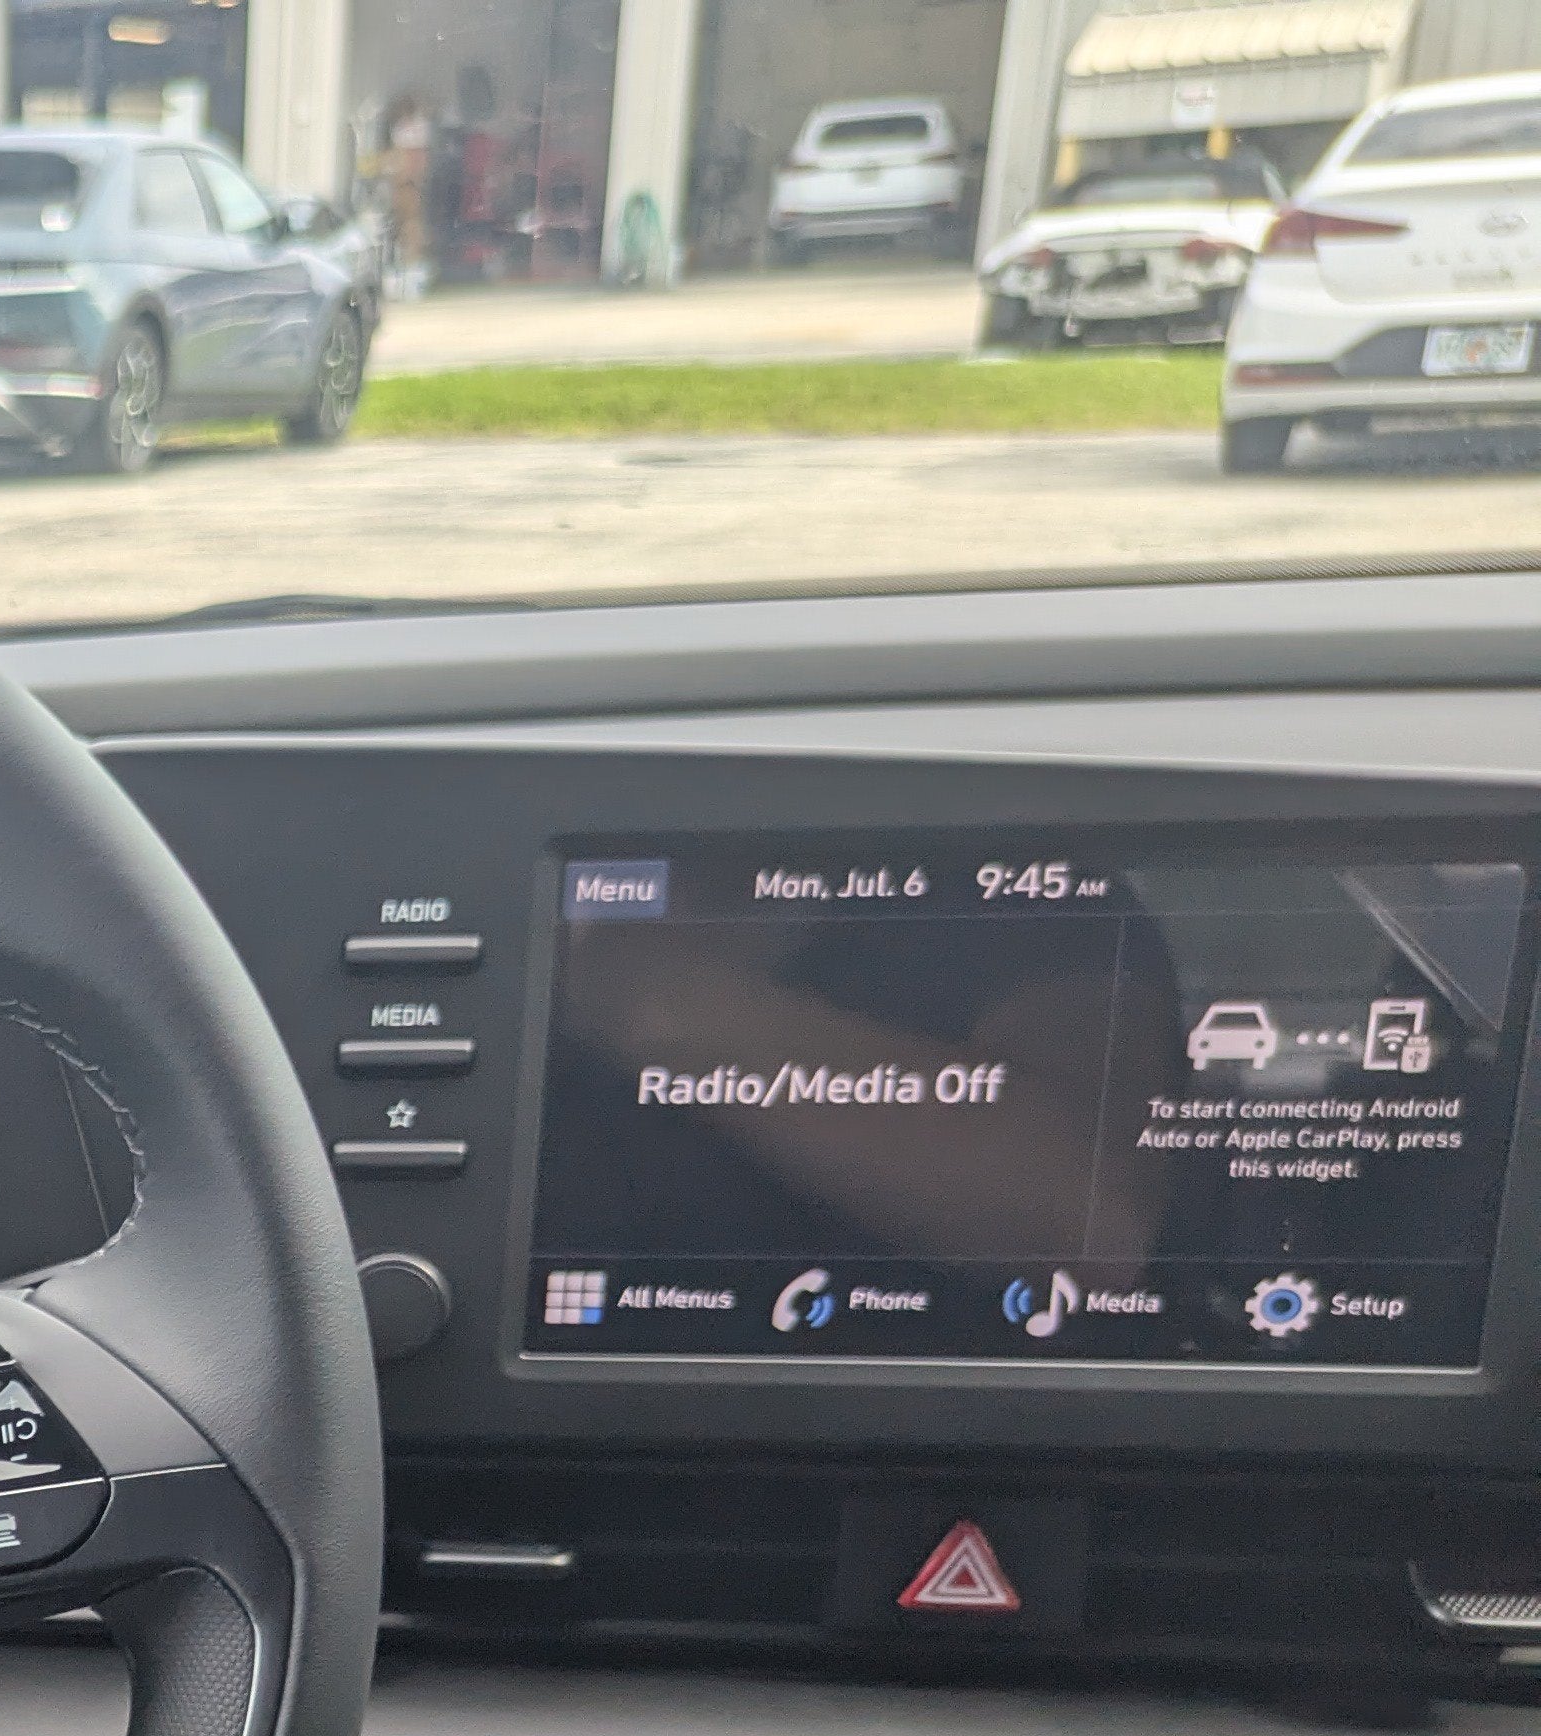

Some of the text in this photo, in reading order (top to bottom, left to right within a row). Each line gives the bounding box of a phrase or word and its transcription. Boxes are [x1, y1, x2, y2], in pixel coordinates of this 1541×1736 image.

[576, 875, 656, 902] Menu
[838, 868, 896, 898] Jul.
[904, 869, 928, 898] 6
[976, 862, 1107, 899] 9:45 AM
[380, 898, 450, 922] RADIO
[371, 1004, 440, 1027] MEDIA
[637, 1060, 1007, 1108] Radio/Media Off
[1148, 1096, 1460, 1122] To start connecting Android
[1136, 1127, 1190, 1148] Auto
[1195, 1130, 1220, 1148] or
[1225, 1127, 1291, 1151] Apple
[1398, 1131, 1462, 1152] press
[1229, 1158, 1358, 1182] this widget.
[618, 1286, 733, 1310] All Menus
[849, 1287, 927, 1311] Phone
[1086, 1292, 1160, 1314] Media
[1330, 1294, 1404, 1320] Setup
